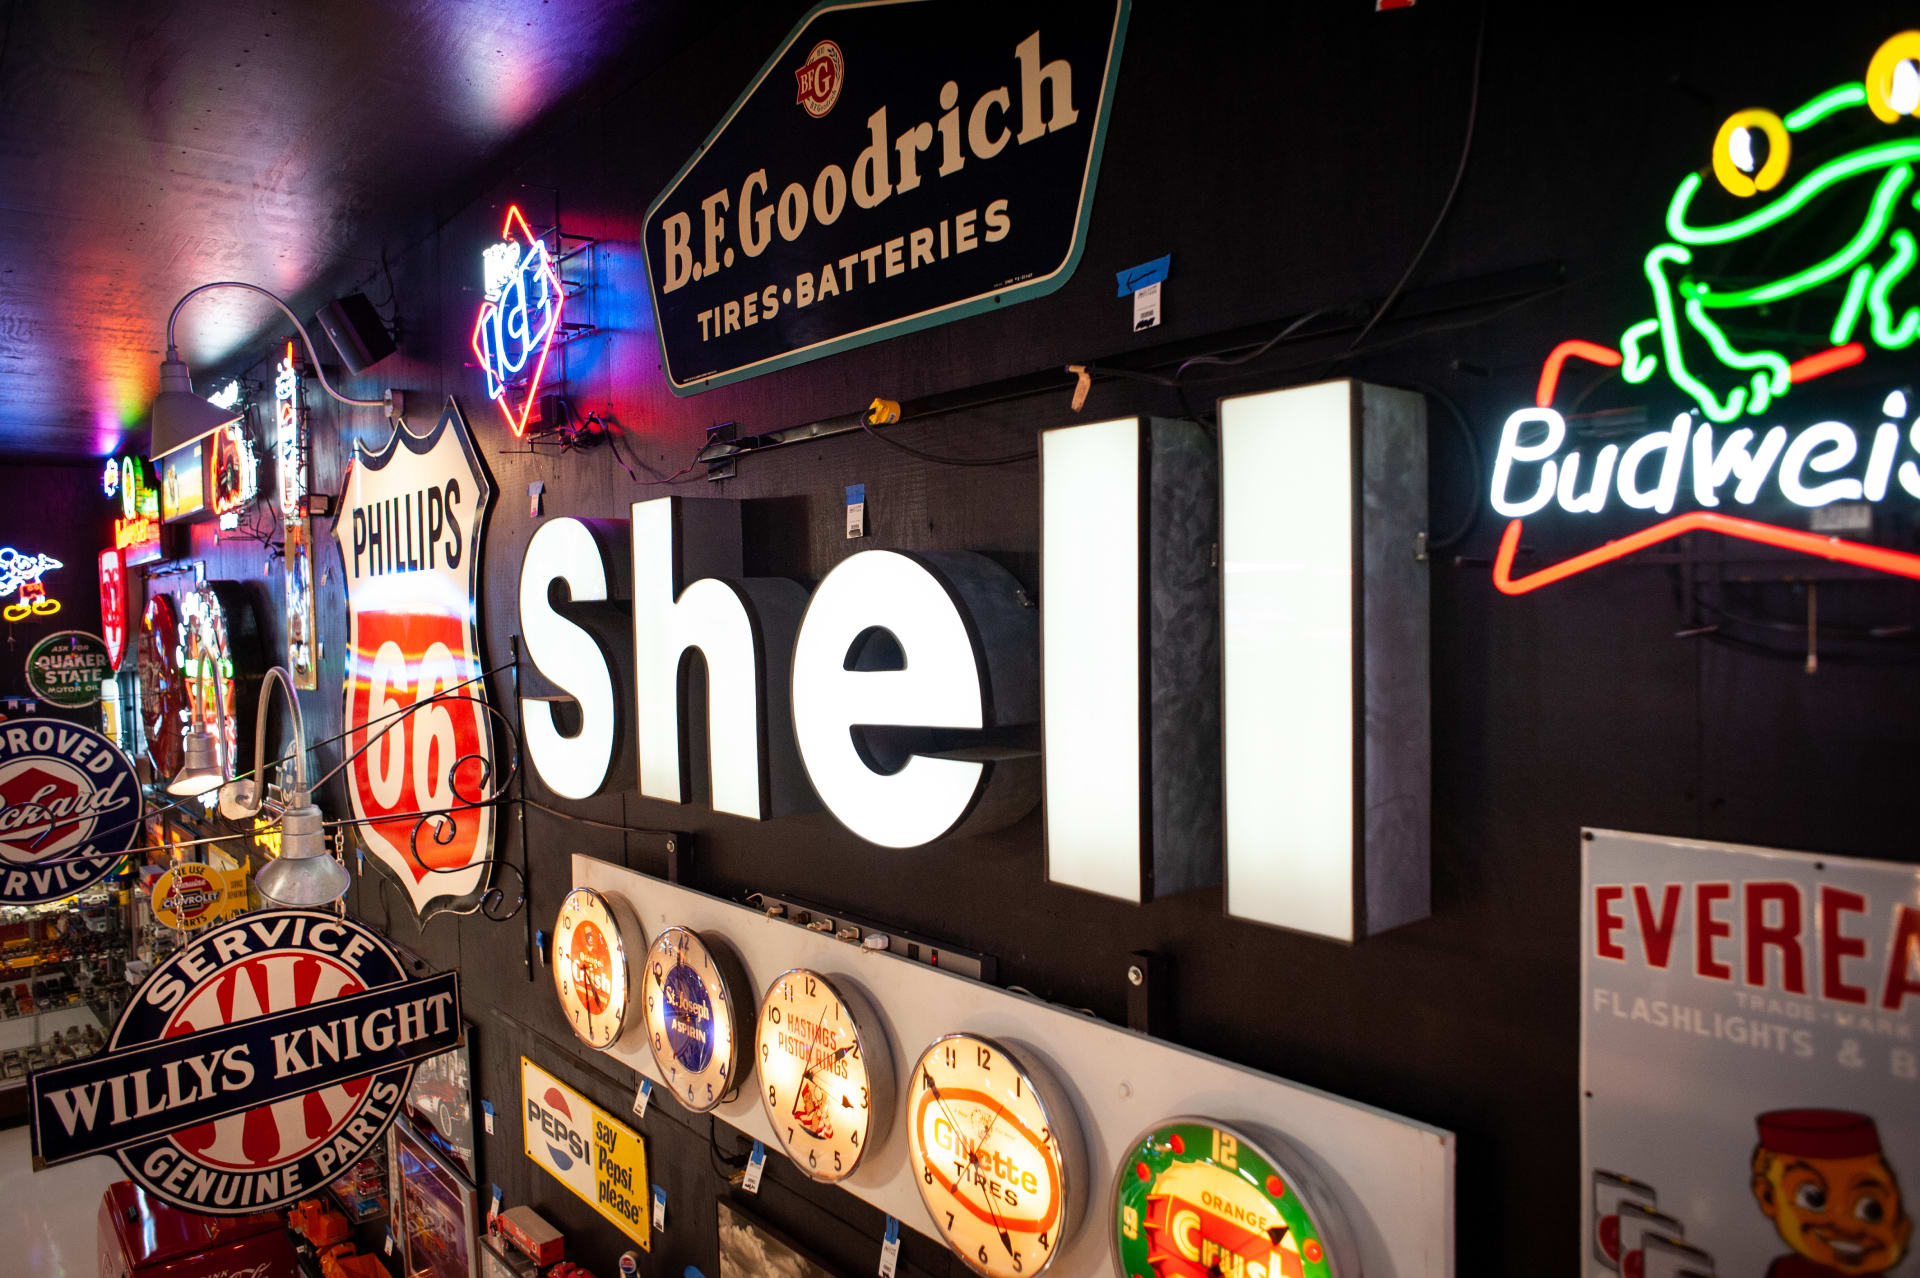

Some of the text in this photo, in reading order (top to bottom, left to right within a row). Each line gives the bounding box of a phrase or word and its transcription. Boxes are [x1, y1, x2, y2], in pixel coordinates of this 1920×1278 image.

[800, 61, 832, 98] BFG
[353, 478, 462, 578] PHILLIPS
[36, 653, 107, 670] QUAKER
[51, 644, 89, 653] ASK FOR
[45, 669, 103, 685] STATE
[47, 685, 82, 694] MOTOR
[0, 726, 114, 773] ROVED
[366, 639, 457, 828] 66
[0, 771, 130, 831] ckard
[0, 844, 110, 897] RVICE
[163, 892, 219, 909] CHVROLET
[145, 917, 375, 1014] SERVICE
[805, 976, 816, 998] 12
[671, 1018, 706, 1044] ASPIRIN
[768, 1004, 781, 1025] 10
[1593, 987, 1814, 1059] FLASHLIGHTS
[1838, 1037, 1865, 1070] &
[787, 1013, 837, 1051] HASTINGS
[43, 991, 455, 1138] WILLYS KNIGHT
[778, 1031, 848, 1080] PISTON RINGS
[977, 1046, 991, 1071] 12
[769, 1085, 776, 1107] 8
[143, 1079, 400, 1207] GENUINE PARTS
[527, 1098, 591, 1166] PEPSI
[595, 1120, 618, 1154] say
[787, 1127, 794, 1144] 7
[850, 1130, 859, 1148] 4
[1211, 1128, 1238, 1170] 12
[808, 1149, 817, 1169] 6
[834, 1151, 842, 1172] 5
[953, 1160, 1018, 1207] TIRES
[945, 1210, 955, 1231] 7
[1200, 1190, 1268, 1234] ORANGE
[978, 1244, 988, 1265] 6
